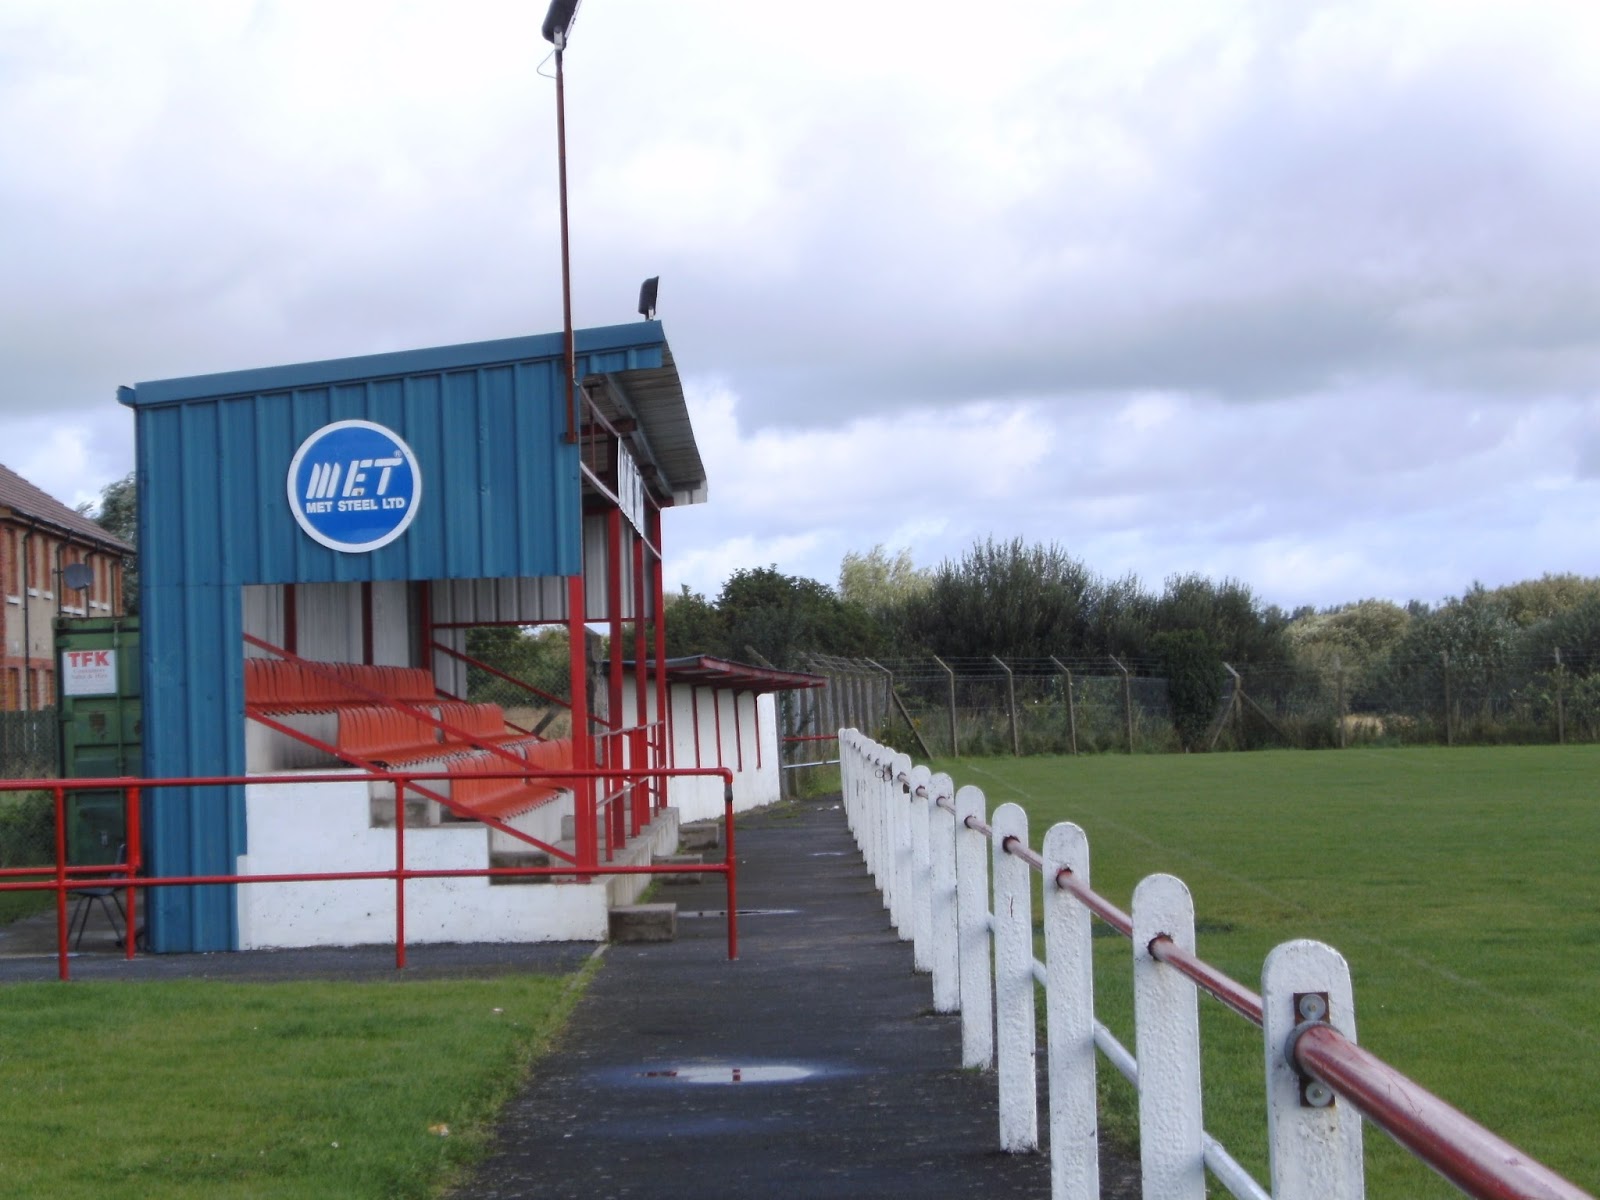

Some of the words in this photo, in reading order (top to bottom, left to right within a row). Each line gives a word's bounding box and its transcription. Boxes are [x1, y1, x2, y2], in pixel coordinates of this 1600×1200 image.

[306, 502, 333, 514] MET
[338, 500, 378, 512] STEEL
[382, 498, 405, 509] LTD
[67, 651, 110, 668] TFK
